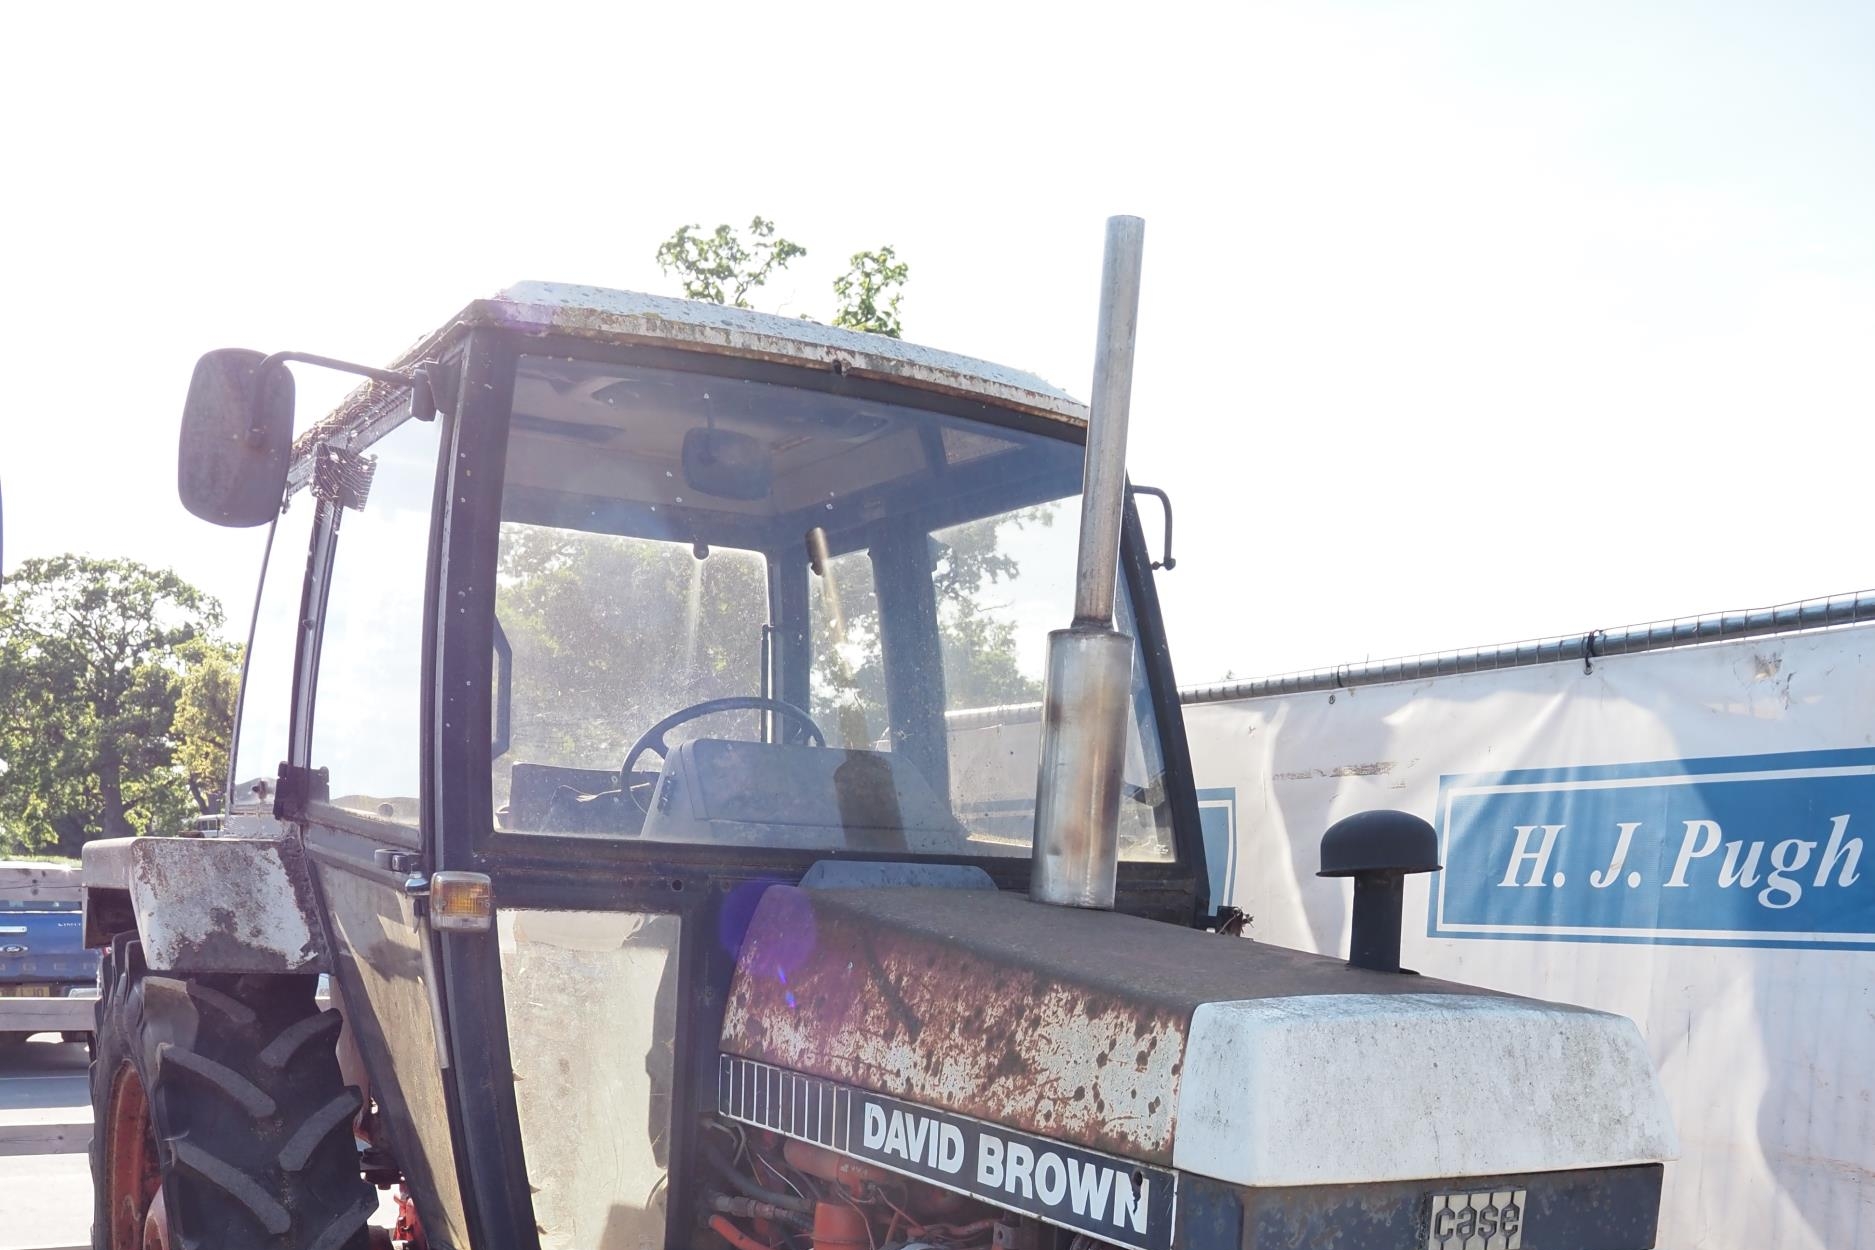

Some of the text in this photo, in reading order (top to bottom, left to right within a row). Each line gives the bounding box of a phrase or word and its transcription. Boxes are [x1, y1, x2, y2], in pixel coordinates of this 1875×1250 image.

[1497, 813, 1865, 910] H. J. Pugh
[863, 1102, 1150, 1235] DAVID BROWN
